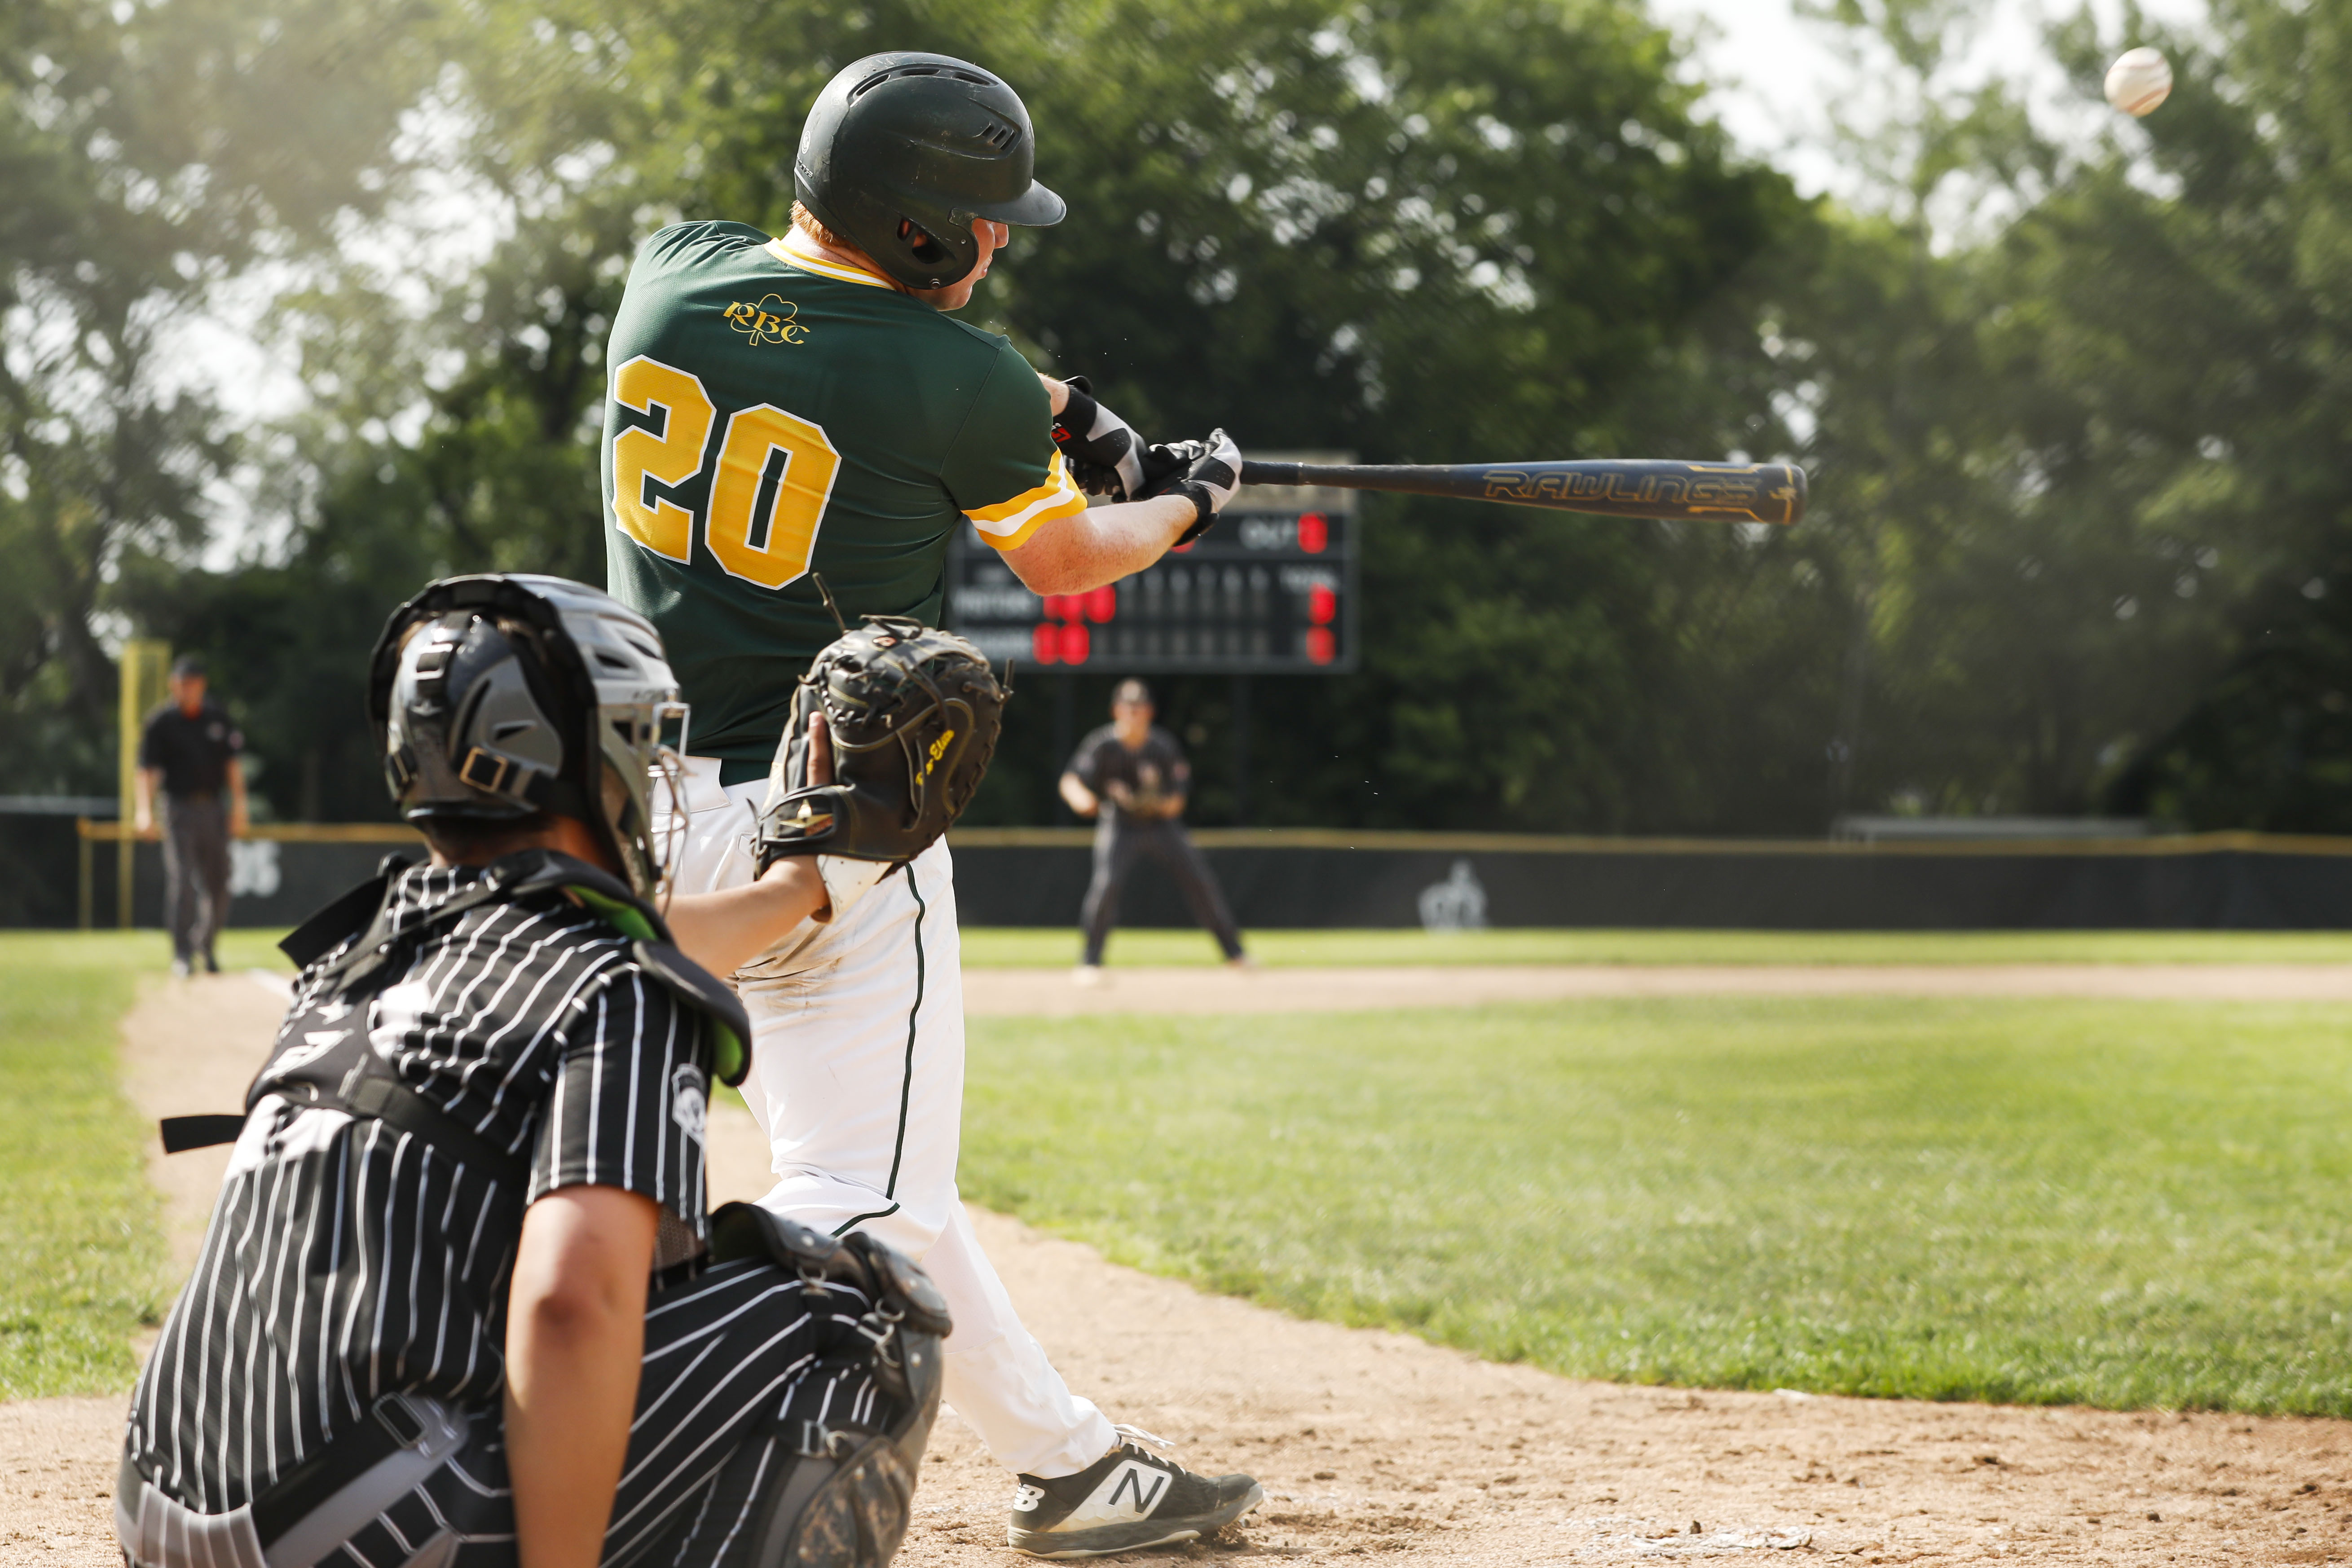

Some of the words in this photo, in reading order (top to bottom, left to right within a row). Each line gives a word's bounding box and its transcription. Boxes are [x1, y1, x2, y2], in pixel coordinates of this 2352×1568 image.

[722, 300, 811, 345] RBC
[611, 354, 842, 590] 20
[1482, 470, 1763, 507] RAWLINGS
